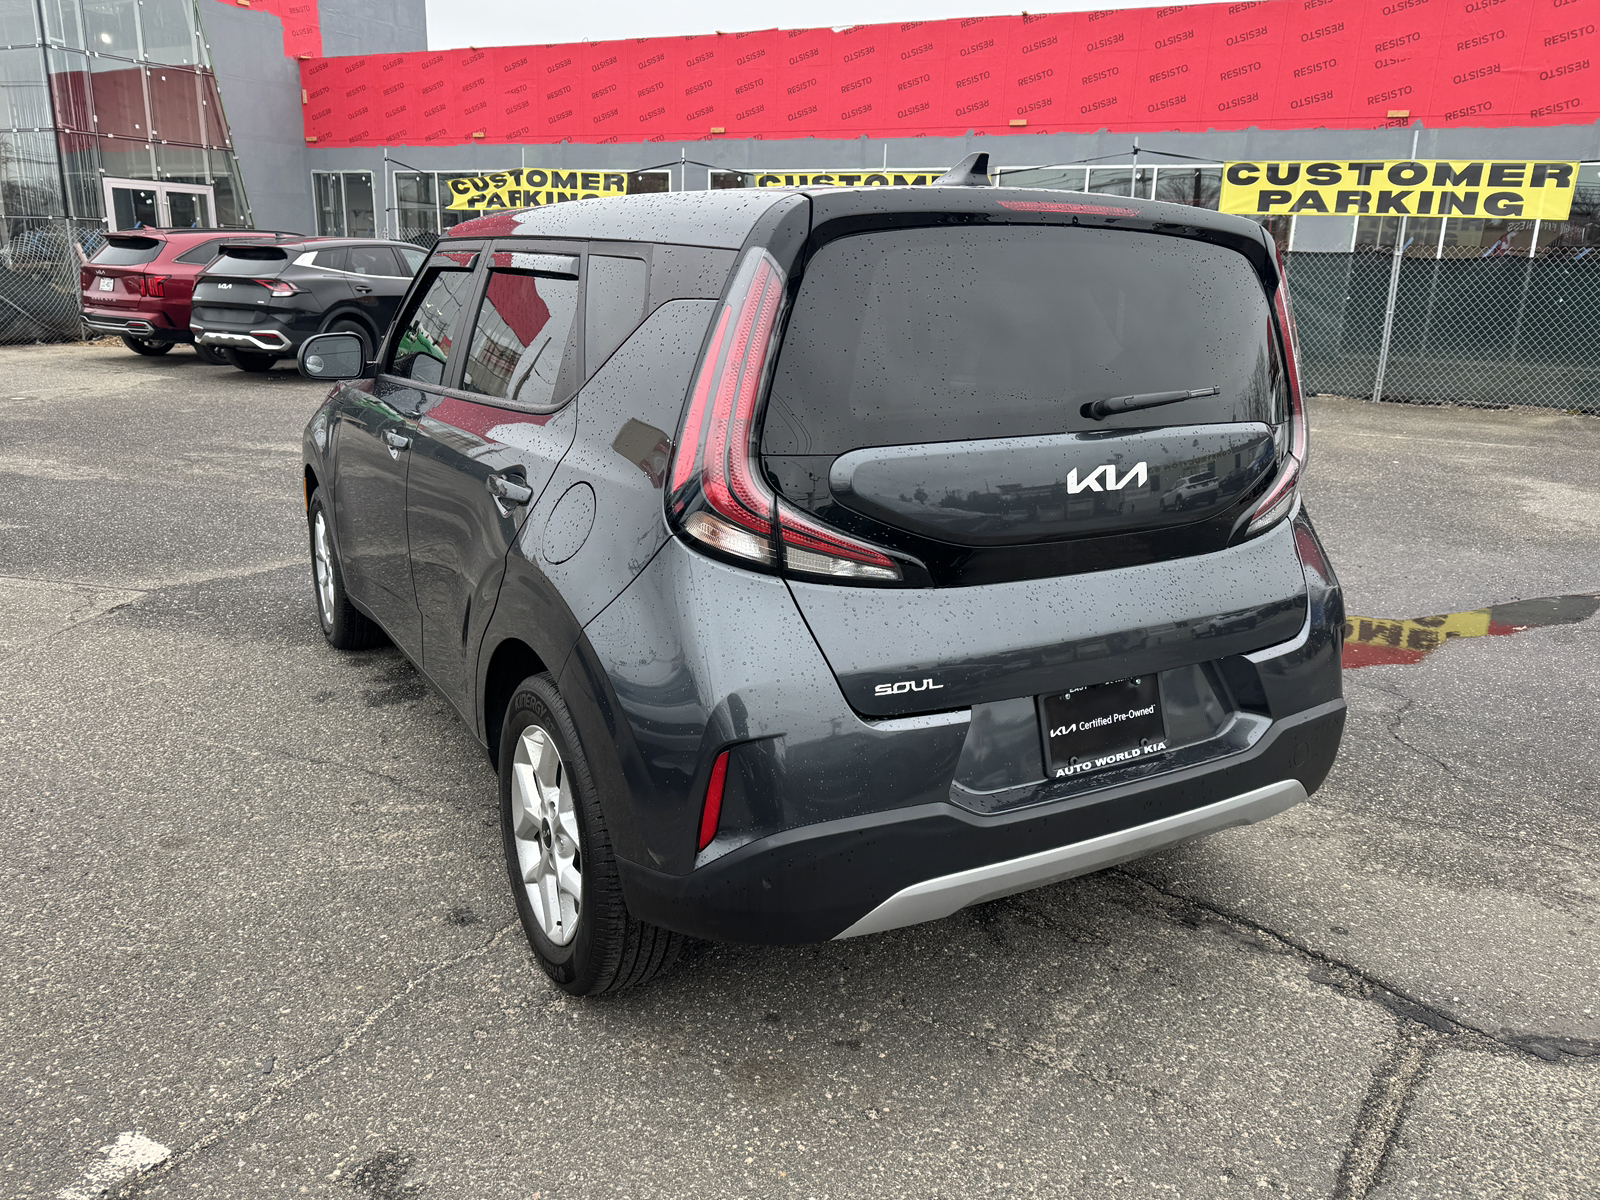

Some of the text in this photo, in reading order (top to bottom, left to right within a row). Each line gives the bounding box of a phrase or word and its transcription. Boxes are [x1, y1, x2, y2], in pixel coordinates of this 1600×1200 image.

[288, 5, 311, 13] RESISTO
[291, 28, 313, 36] RESISTO
[1155, 30, 1194, 49] RESISTO
[1226, 26, 1268, 46] RESISTO
[1301, 22, 1344, 42] RESISTO
[1544, 25, 1595, 46] RESISTO
[960, 39, 994, 56] RESISTO
[1022, 36, 1057, 54] RESISTO
[1087, 33, 1124, 52] RESISTO
[1375, 32, 1420, 53] RESISTO
[1458, 30, 1505, 51] RESISTO
[462, 51, 485, 66] RESISTO
[687, 52, 714, 67] RESISTO
[737, 49, 765, 65] RESISTO
[790, 48, 819, 65] RESISTO
[844, 46, 875, 63] RESISTO
[901, 43, 933, 60] RESISTO
[309, 63, 329, 75] RESISTO
[344, 60, 366, 73] RESISTO
[382, 58, 404, 71] RESISTO
[421, 56, 444, 69] RESISTO
[503, 58, 528, 72] RESISTO
[547, 59, 572, 73] RESISTO
[591, 56, 618, 72] RESISTO
[637, 54, 665, 69] RESISTO
[1294, 59, 1336, 78] RESISTO
[1018, 69, 1054, 86] RESISTO
[1082, 67, 1119, 84] RESISTO
[1150, 65, 1188, 83] RESISTO
[1220, 62, 1261, 81] RESISTO
[1454, 64, 1500, 84] RESISTO
[1540, 60, 1590, 80] RESISTO
[421, 81, 444, 94] RESISTO
[462, 78, 485, 92] RESISTO
[736, 79, 764, 95] RESISTO
[788, 78, 816, 95] RESISTO
[841, 77, 872, 93] RESISTO
[898, 74, 930, 91] RESISTO
[956, 71, 990, 88] RESISTO
[309, 86, 330, 98] RESISTO
[345, 85, 367, 97] RESISTO
[382, 83, 405, 96] RESISTO
[546, 86, 572, 100] RESISTO
[591, 84, 617, 99] RESISTO
[637, 82, 665, 97] RESISTO
[685, 80, 713, 96] RESISTO
[1368, 86, 1412, 105] RESISTO
[505, 101, 530, 114] RESISTO
[1017, 98, 1052, 115] RESISTO
[1081, 97, 1117, 114] RESISTO
[1148, 94, 1186, 112] RESISTO
[1218, 92, 1258, 111] RESISTO
[1291, 90, 1333, 109] RESISTO
[311, 109, 332, 120] RESISTO
[348, 108, 369, 119] RESISTO
[385, 106, 407, 118] RESISTO
[424, 104, 447, 117] RESISTO
[464, 102, 487, 115] RESISTO
[593, 108, 619, 123] RESISTO
[639, 107, 666, 122] RESISTO
[687, 106, 714, 121] RESISTO
[736, 105, 764, 120] RESISTO
[788, 105, 817, 121] RESISTO
[842, 104, 872, 120] RESISTO
[898, 102, 930, 118] RESISTO
[956, 100, 989, 116] RESISTO
[1445, 102, 1492, 121] RESISTO
[1530, 98, 1580, 118] RESISTO
[548, 110, 573, 124] RESISTO
[348, 131, 369, 142] RESISTO
[385, 130, 407, 142] RESISTO
[424, 129, 447, 141] RESISTO
[505, 127, 530, 140] RESISTO
[450, 169, 625, 195] CUSTOMER
[758, 174, 943, 186] CUSTOM
[1226, 162, 1575, 189] CUSTOMER
[467, 189, 601, 208] PARKIN
[1257, 190, 1525, 217] PARKING
[1066, 461, 1148, 494] KIA
[874, 678, 944, 696] SOUL
[515, 693, 547, 717] KINERGY
[1050, 705, 1154, 737] KIA Certified Pre-Owned
[1055, 761, 1091, 778] AUTO
[1094, 748, 1141, 767] WORLD
[1144, 742, 1167, 754] KIA
